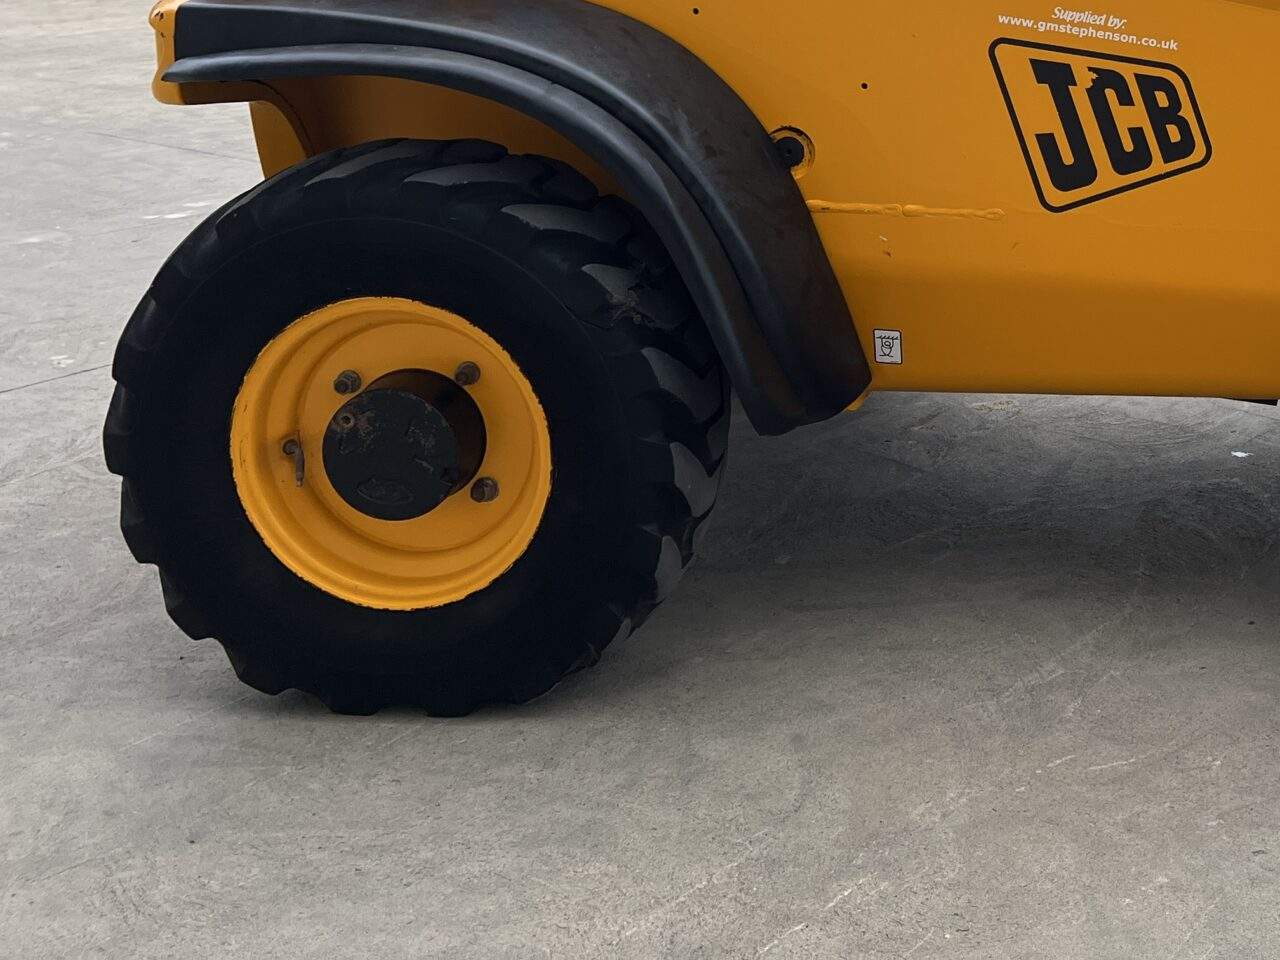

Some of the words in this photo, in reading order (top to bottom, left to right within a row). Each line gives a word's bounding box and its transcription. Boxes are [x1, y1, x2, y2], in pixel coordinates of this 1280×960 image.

[998, 13, 1179, 50] www.gmstephenson.co.uk
[1052, 6, 1105, 26] Supplied
[1108, 15, 1127, 30] by:
[1028, 58, 1196, 193] JCB
